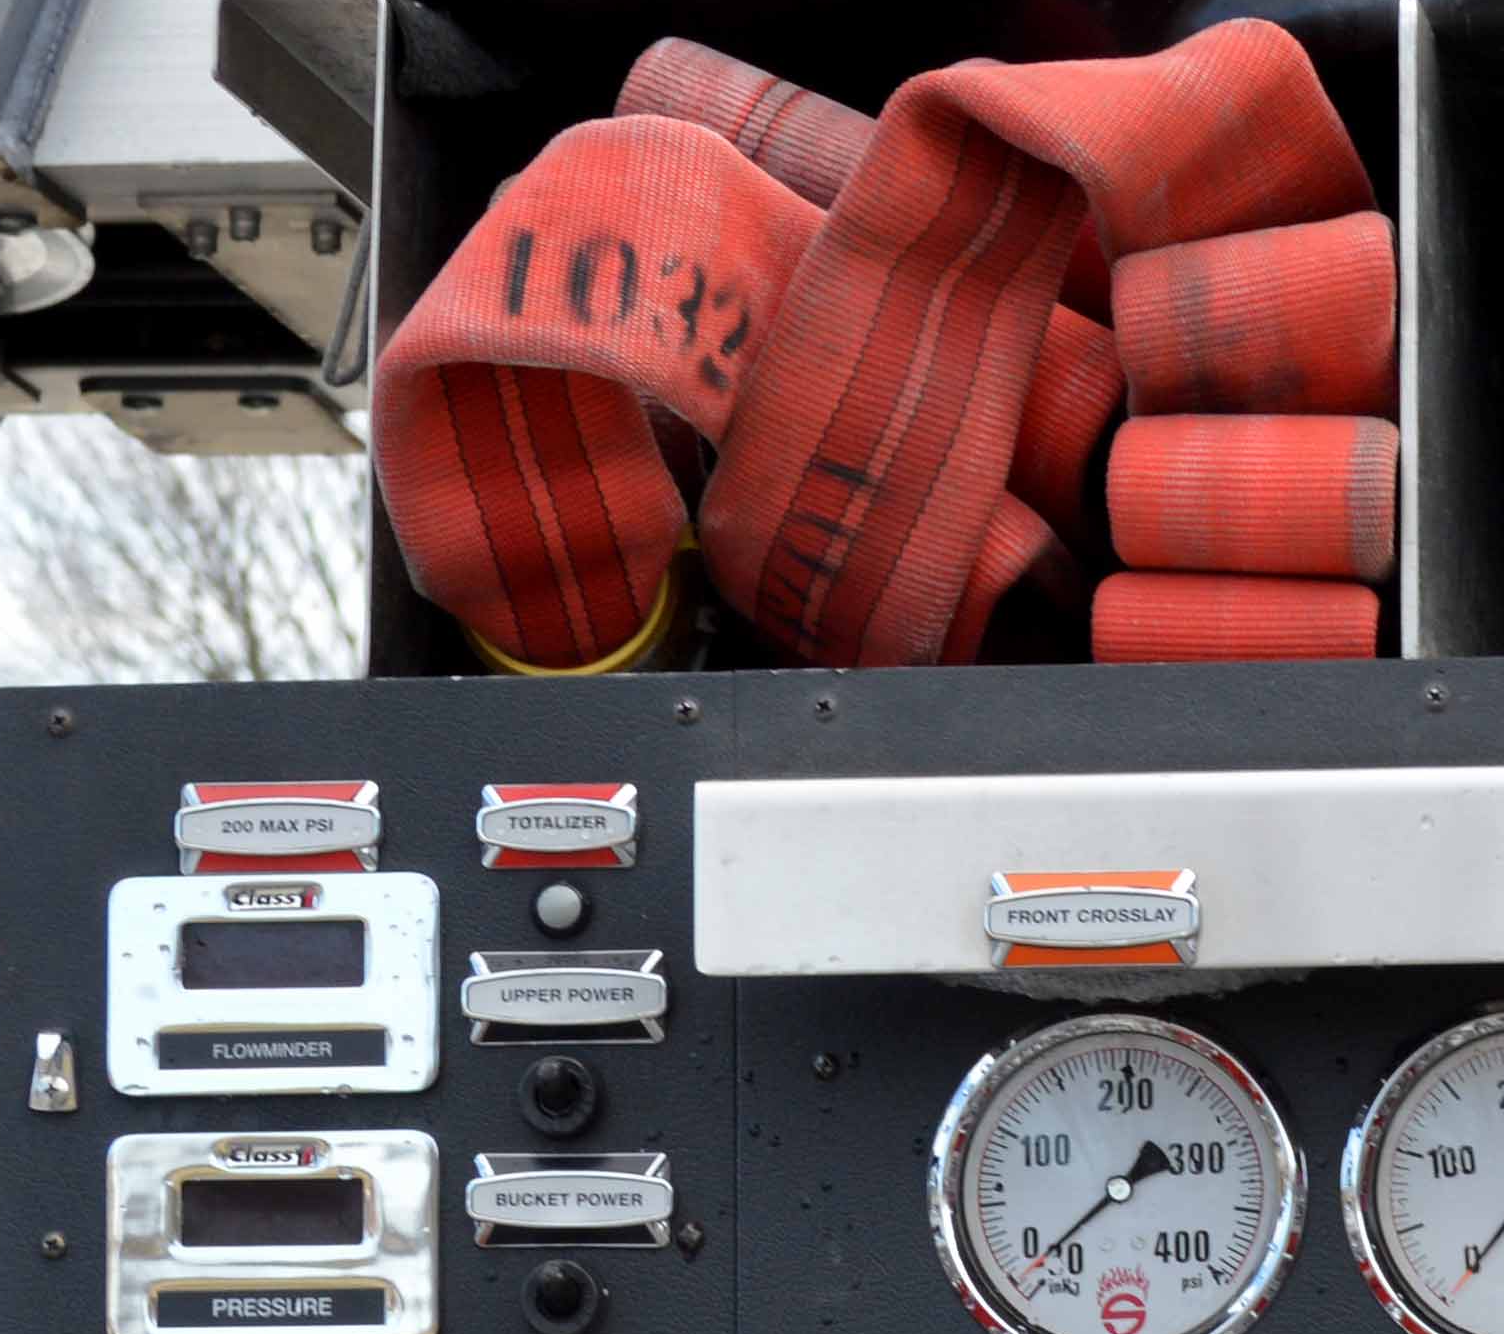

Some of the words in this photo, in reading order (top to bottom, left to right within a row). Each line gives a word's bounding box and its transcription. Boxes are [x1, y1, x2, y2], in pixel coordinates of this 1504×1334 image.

[221, 819, 254, 834] 200
[259, 819, 297, 834] MAX
[304, 818, 334, 833] PSI
[507, 814, 607, 830] TOTALIZER
[1007, 909, 1069, 924] FRONT
[1077, 909, 1177, 924] CROSSLAY
[500, 988, 562, 1004] UPPER
[569, 987, 634, 1003] POWER
[212, 1040, 333, 1060] FLOWMINDER
[1021, 1135, 1070, 1167] 100
[1429, 1145, 1475, 1179] 100
[496, 1193, 568, 1209] BUCKET
[575, 1192, 643, 1208] POWER
[1154, 1230, 1210, 1263] 400
[211, 1298, 333, 1319] PRESSURE
